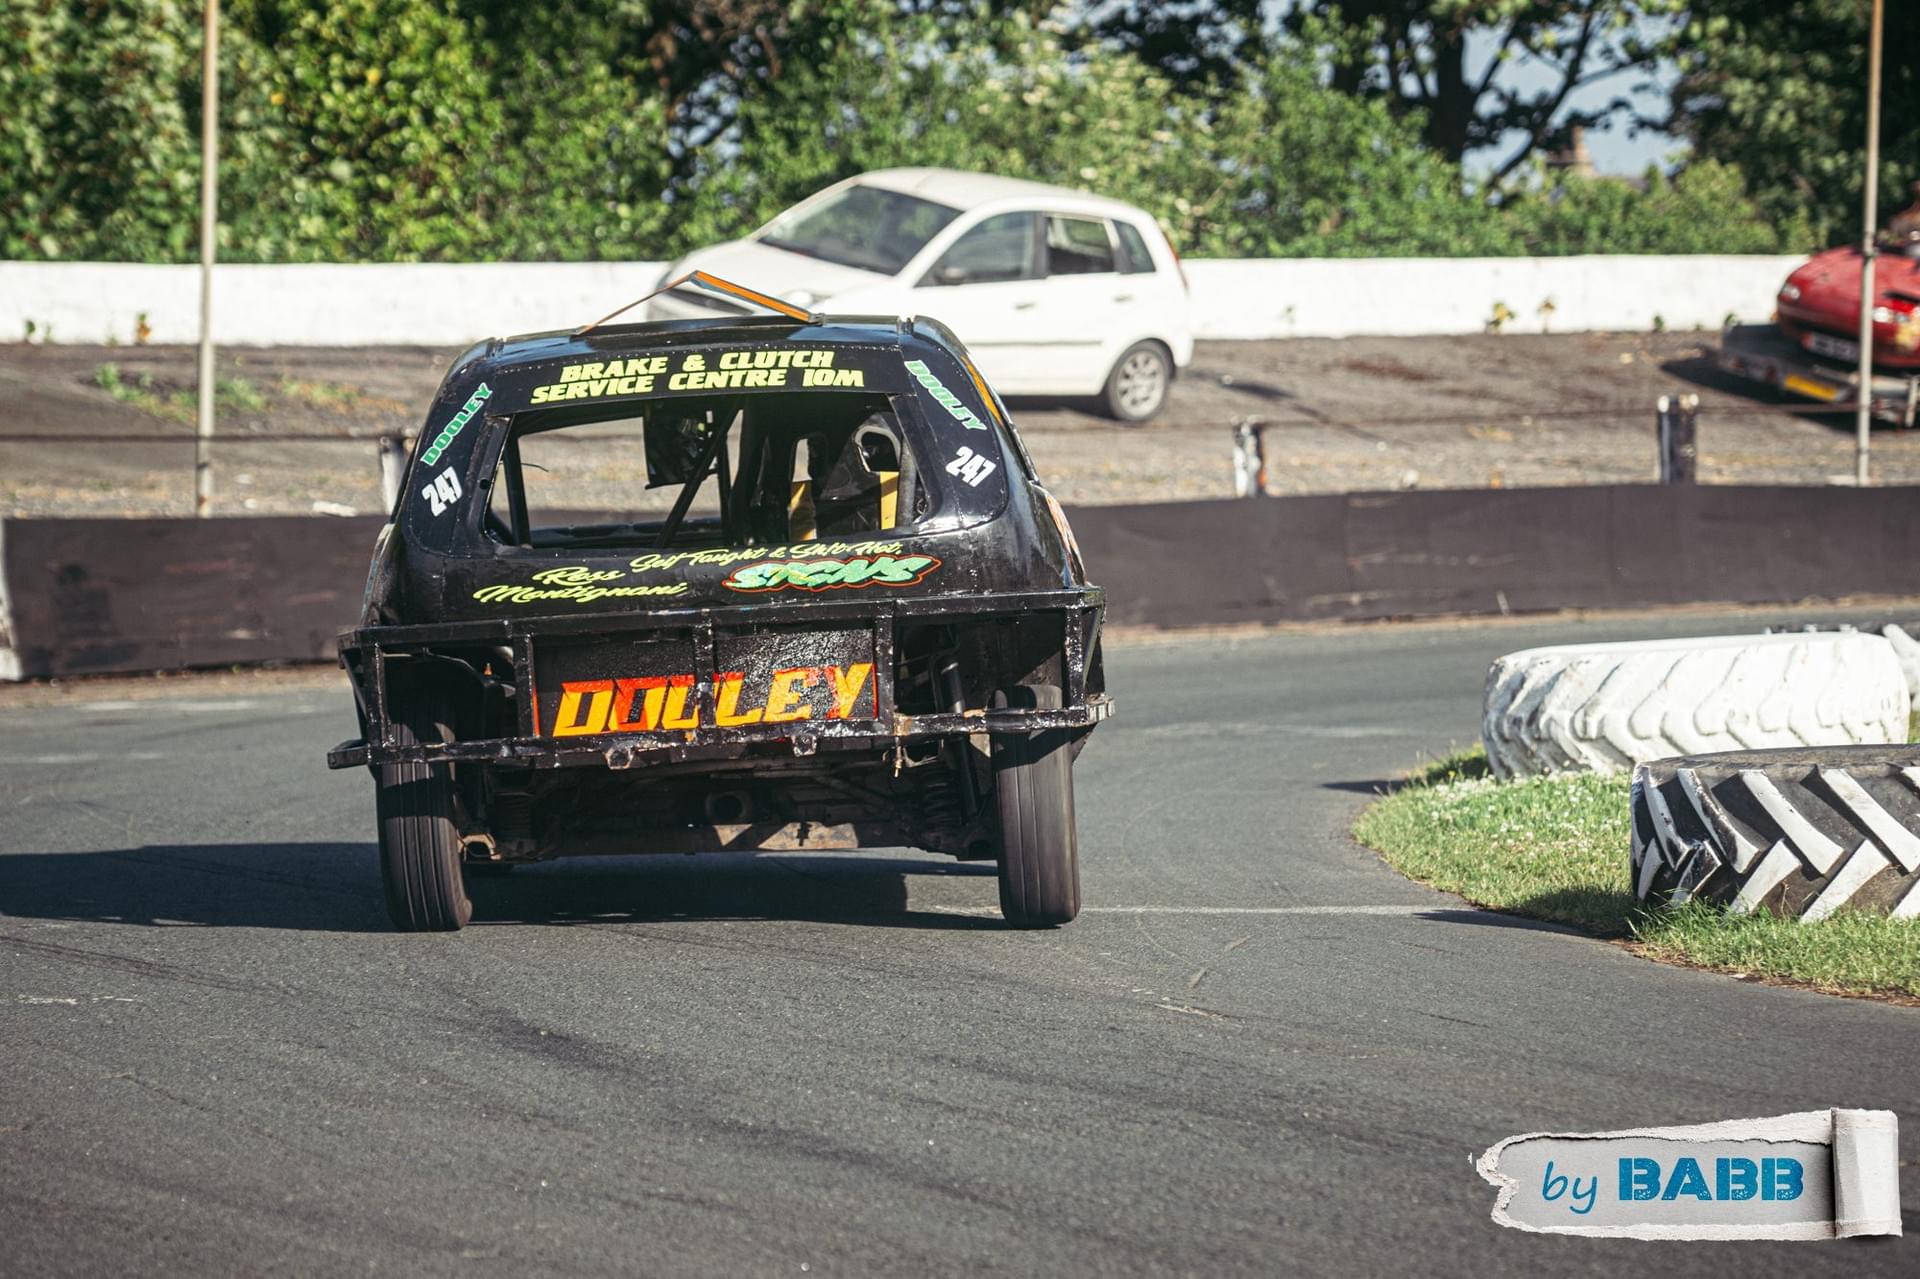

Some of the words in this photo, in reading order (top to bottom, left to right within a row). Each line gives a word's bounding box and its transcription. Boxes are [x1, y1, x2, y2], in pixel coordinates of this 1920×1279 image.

[560, 357, 668, 383] BRAKE
[683, 355, 706, 372] &
[719, 350, 834, 370] CLUTCH
[530, 375, 654, 404] SERVICE
[668, 369, 787, 390] CENTRE
[904, 360, 988, 430] DOOLEY
[420, 382, 493, 466] DOOLEY
[945, 446, 996, 487] 247
[422, 466, 462, 516] 247
[532, 566, 626, 586] Ross
[629, 552, 690, 573] Self
[688, 549, 769, 566] Taught
[769, 546, 787, 558] &
